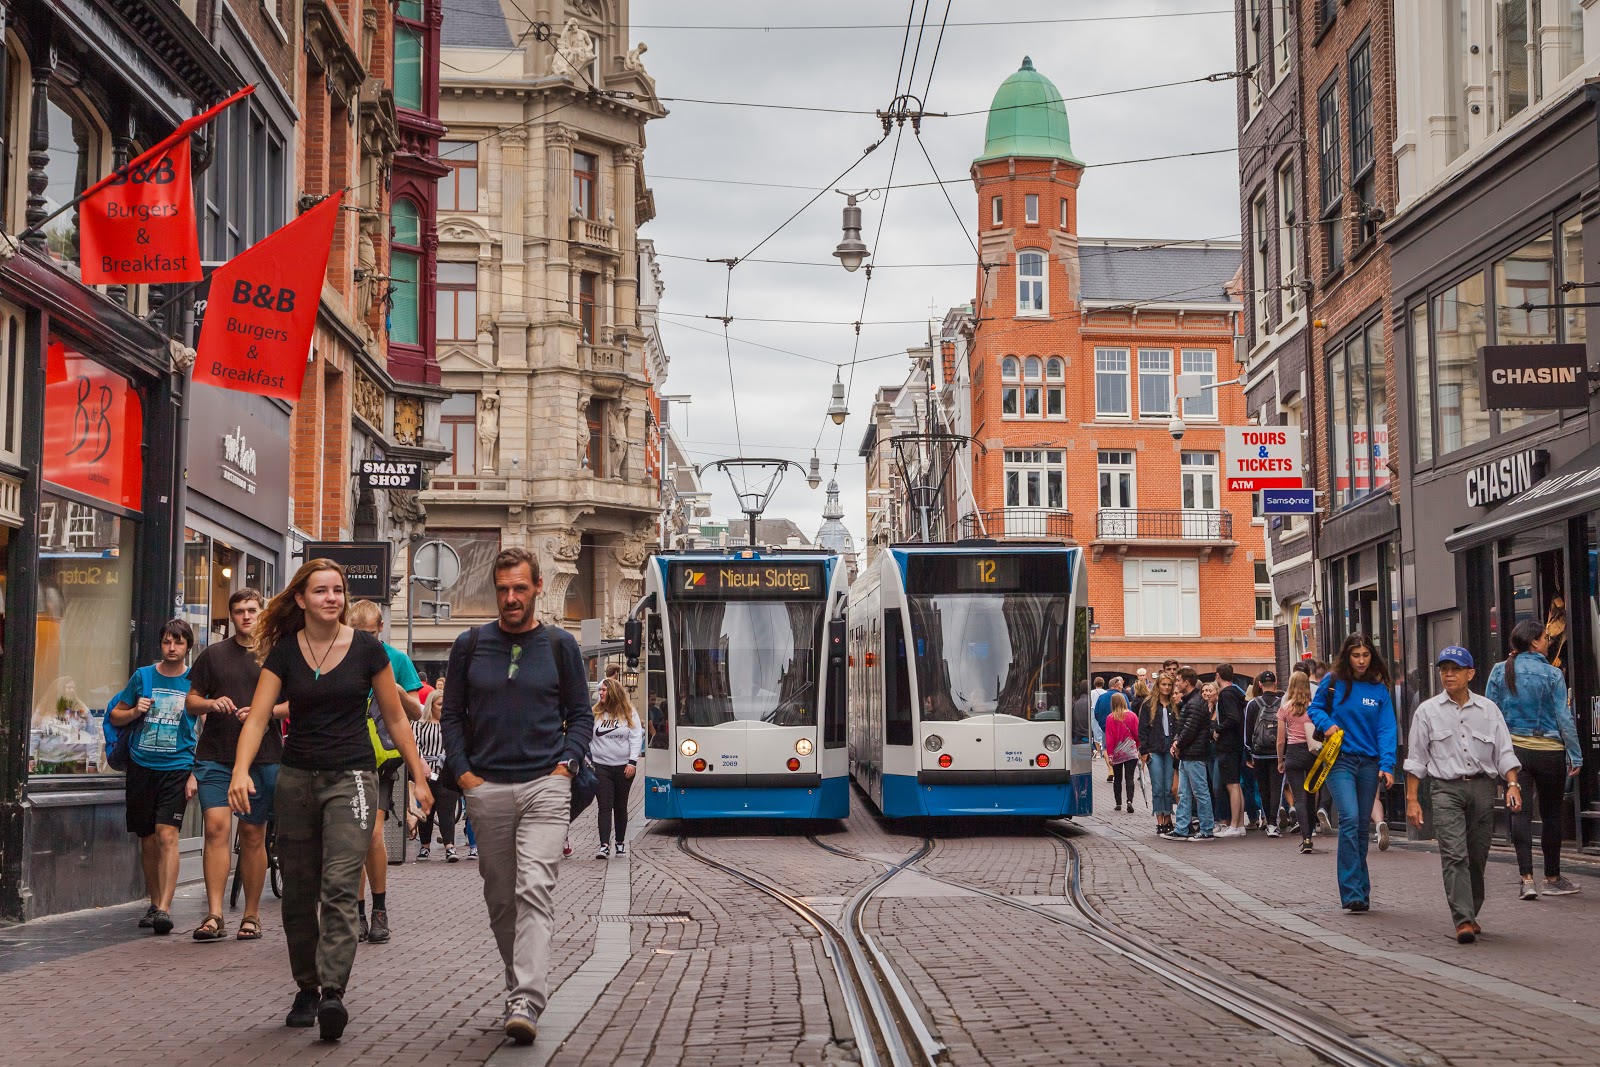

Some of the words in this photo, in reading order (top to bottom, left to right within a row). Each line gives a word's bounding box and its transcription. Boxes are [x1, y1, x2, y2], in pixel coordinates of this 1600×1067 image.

[107, 202, 179, 221] Burgers
[136, 228, 150, 244] &
[102, 254, 187, 272] Breakfast
[232, 279, 296, 313] B&B
[226, 317, 288, 342] Burgers
[246, 345, 259, 359] &
[211, 361, 285, 388] Breakfast
[1492, 367, 1582, 385] CHASIN'
[1242, 432, 1287, 445] TOURS
[1258, 446, 1269, 458] &
[363, 462, 417, 474] SMART
[1237, 458, 1292, 472] TICKETS
[369, 474, 410, 486] SHOP
[1231, 480, 1254, 489] ATM
[1466, 449, 1536, 507] CHASIN'
[1266, 497, 1310, 505] Samsonite
[684, 568, 694, 590] 2
[720, 569, 760, 587] Nieuw
[765, 569, 809, 587] Sloten
[976, 559, 996, 583] 12
